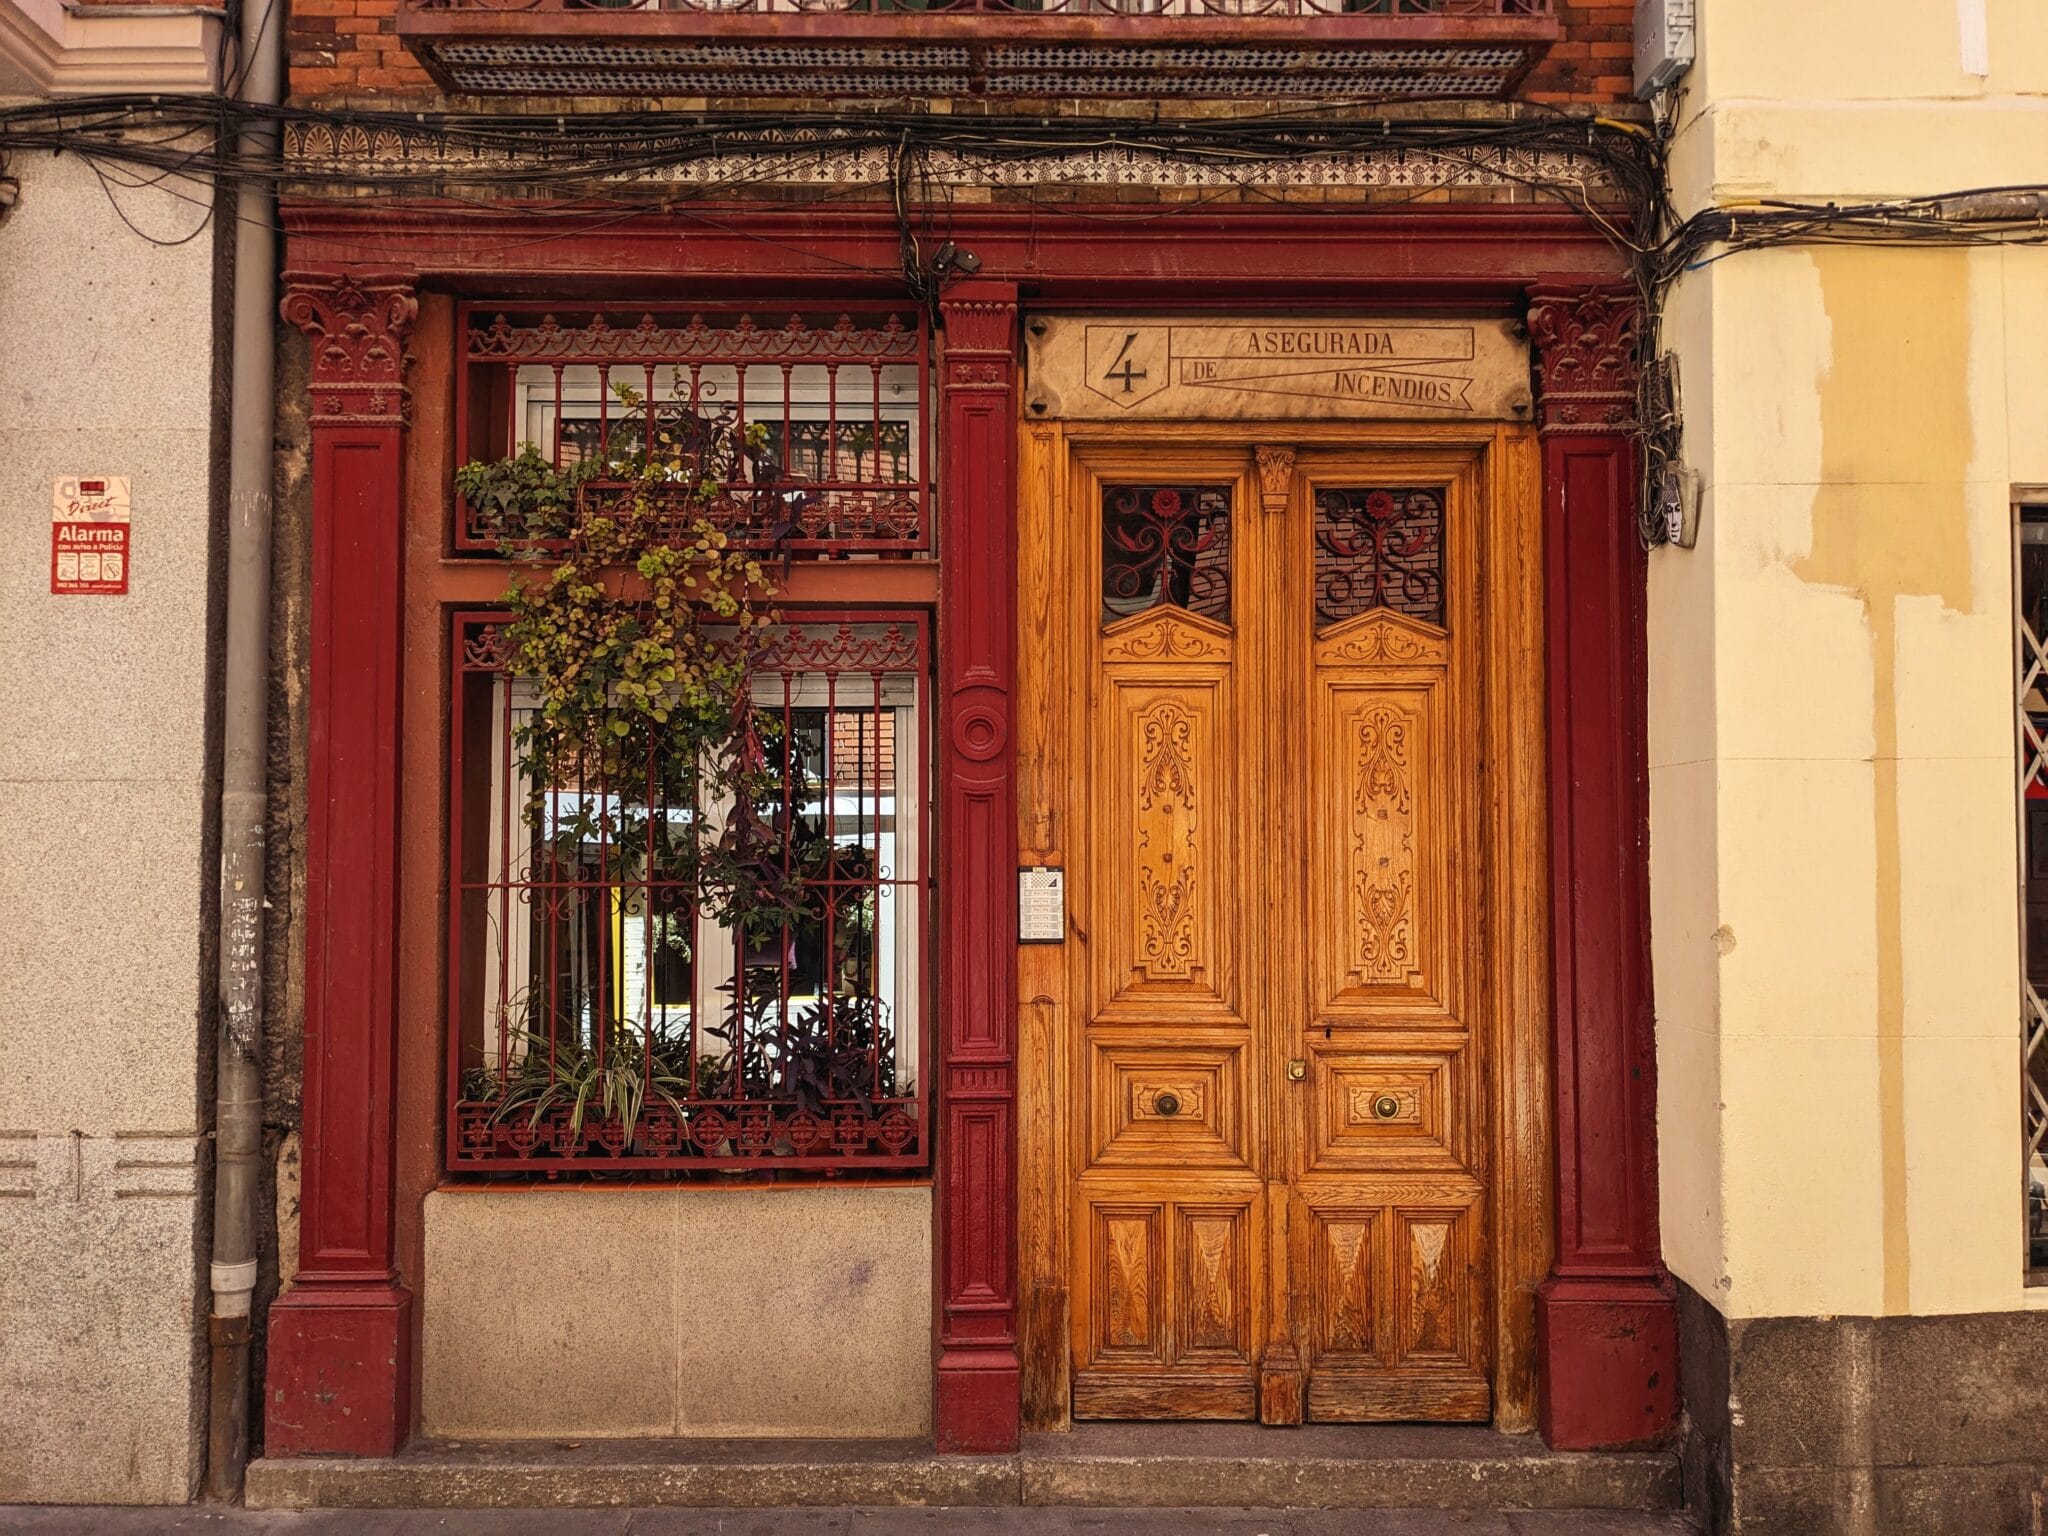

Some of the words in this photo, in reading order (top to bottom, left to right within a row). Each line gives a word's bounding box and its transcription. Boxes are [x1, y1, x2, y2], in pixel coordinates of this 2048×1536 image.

[1247, 331, 1394, 355] ASEGURADA
[1103, 331, 1147, 393] 4
[1193, 360, 1217, 380] DE
[67, 496, 118, 517] Direct
[58, 525, 124, 542] Alarma
